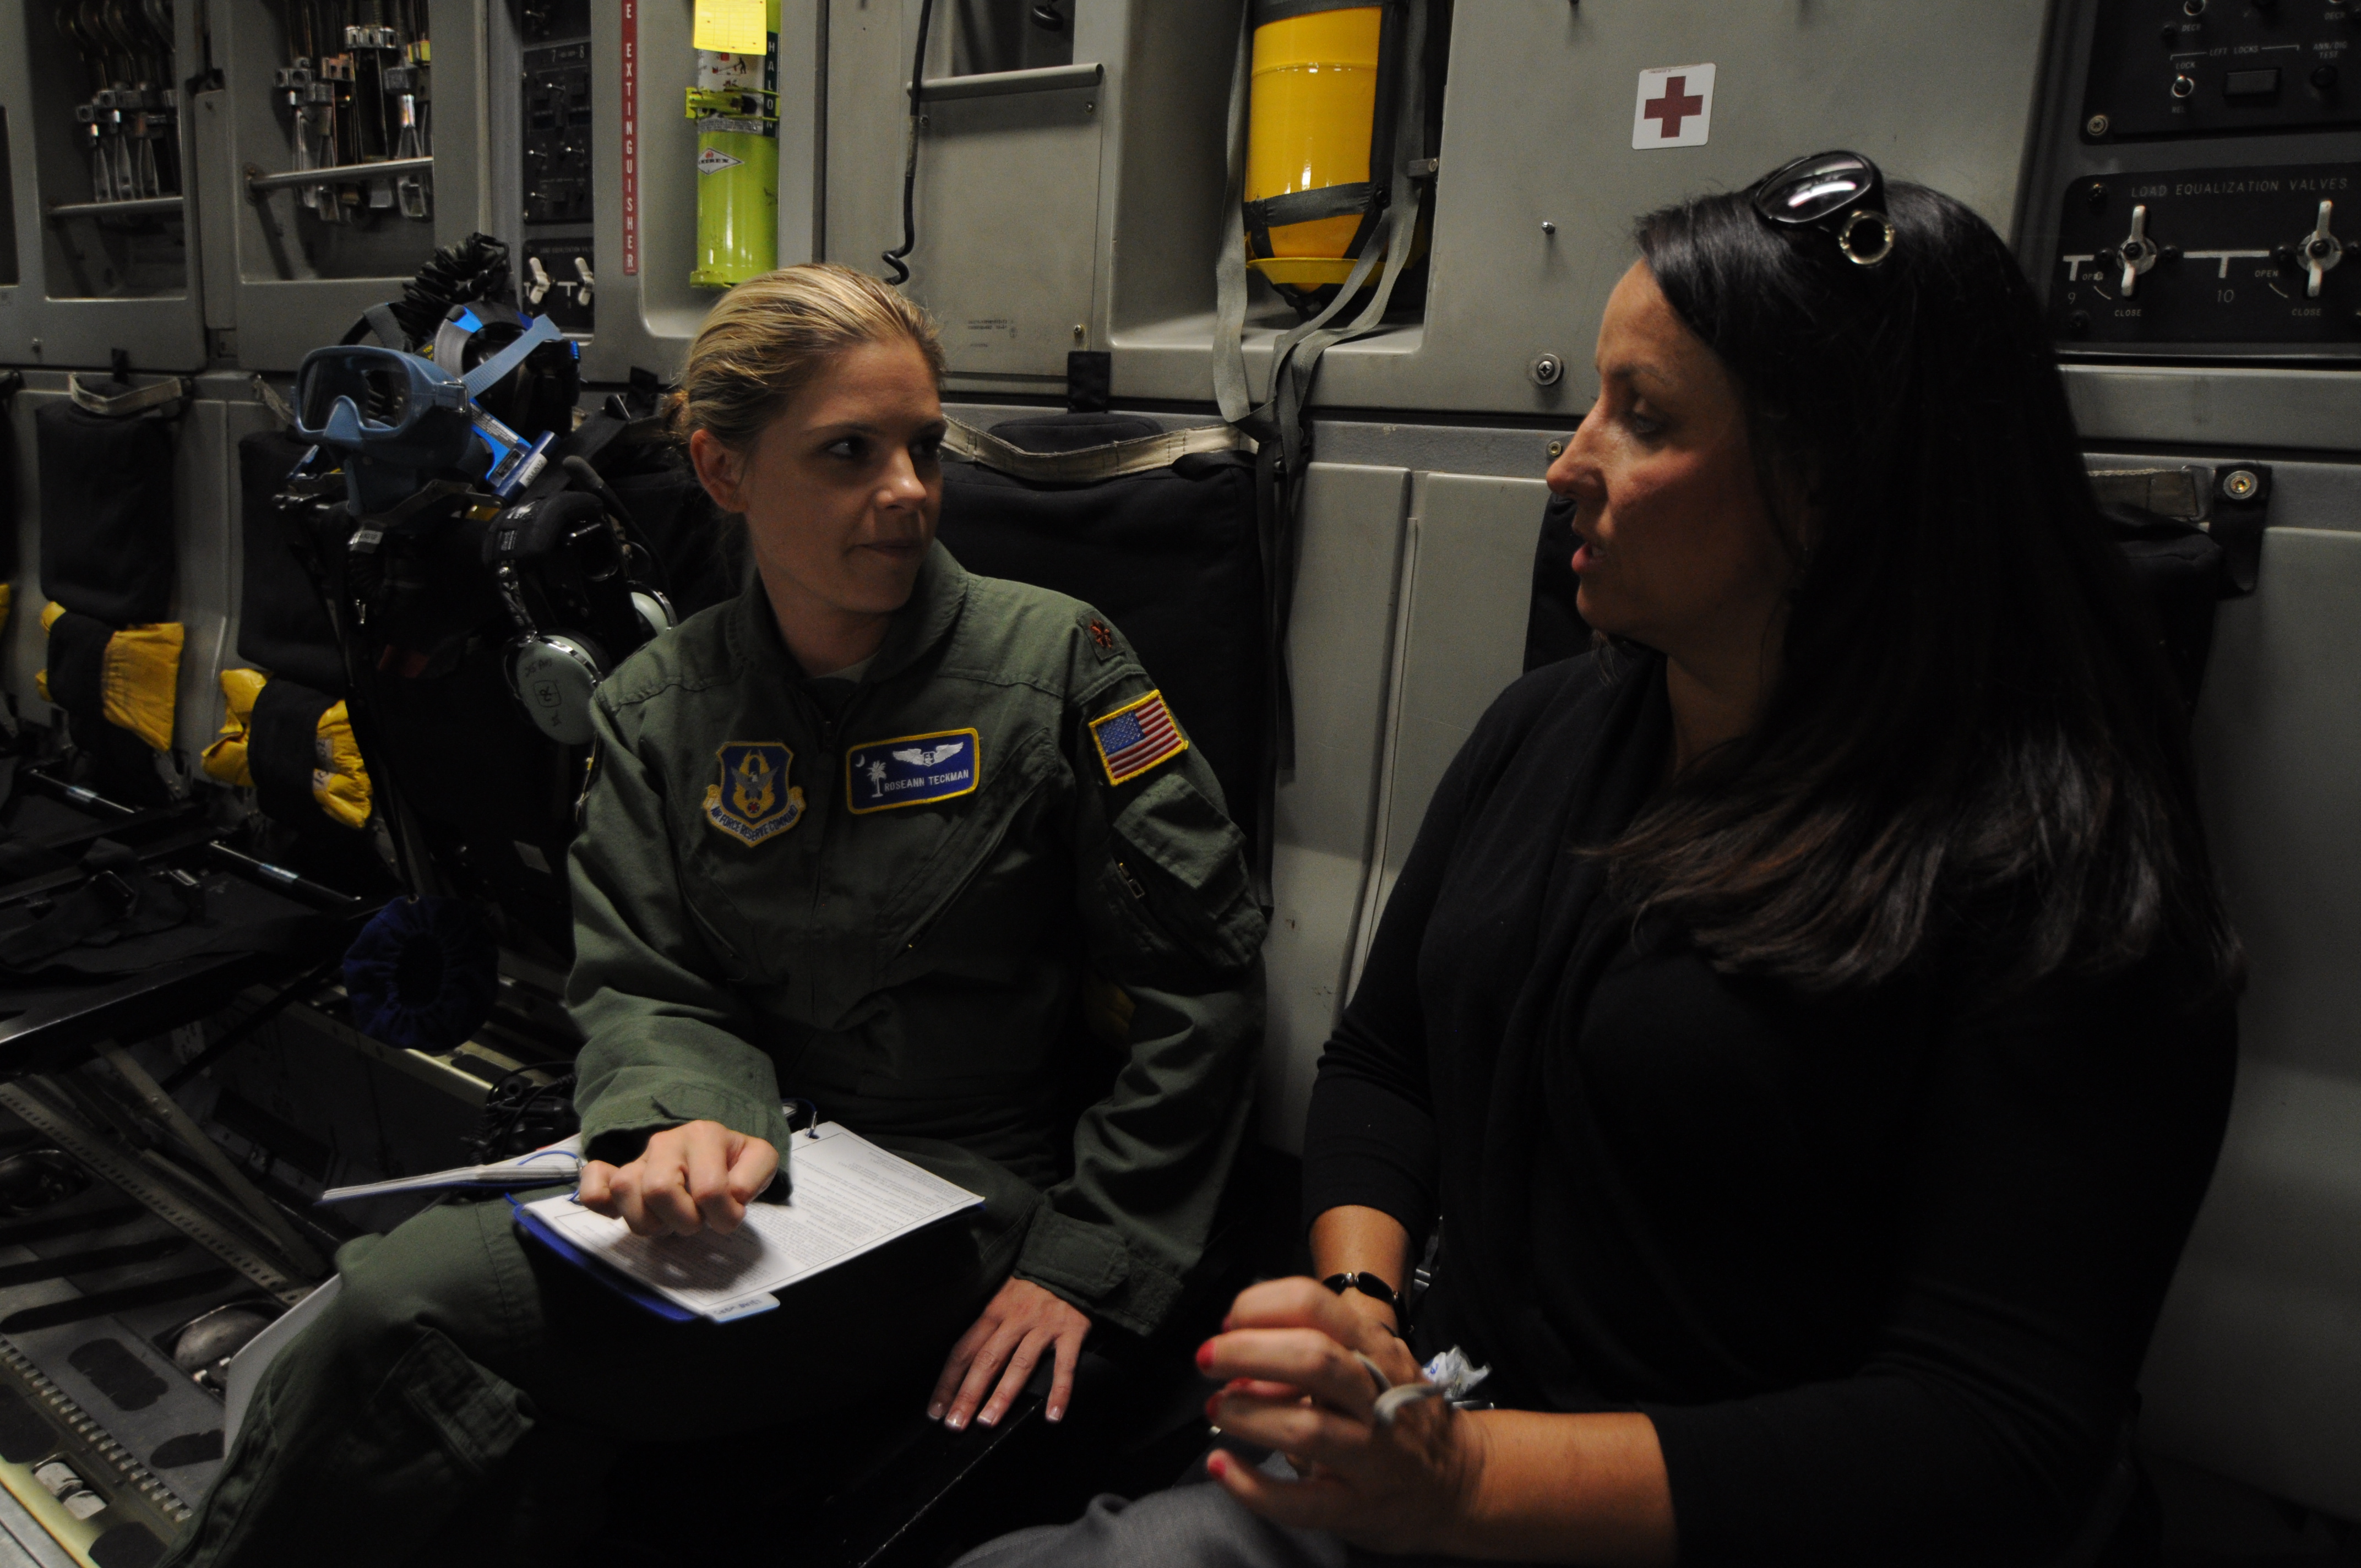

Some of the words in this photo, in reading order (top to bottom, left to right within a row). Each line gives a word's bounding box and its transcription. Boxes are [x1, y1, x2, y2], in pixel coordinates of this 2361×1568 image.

[2210, 47, 2227, 56] LEFT
[2234, 45, 2259, 54] LOCKS
[2319, 51, 2338, 59] TEST
[2175, 61, 2196, 70] LOCK
[625, 42, 634, 269] EXTINGUISHER
[2131, 184, 2167, 198] LOAD
[2176, 180, 2280, 194] EQUALIZATION
[2289, 178, 2348, 192] VALVES
[2254, 269, 2279, 278] OPEN
[2068, 292, 2076, 306] 9
[2217, 290, 2234, 303] 10
[2292, 308, 2322, 317] CLOSE
[885, 777, 925, 792] ROSEANN
[928, 769, 969, 786] TECKMAN
[711, 806, 722, 819] AIR
[719, 815, 742, 832] FORCE
[740, 825, 769, 841] RESERVE
[769, 804, 798, 831] COMMAND
